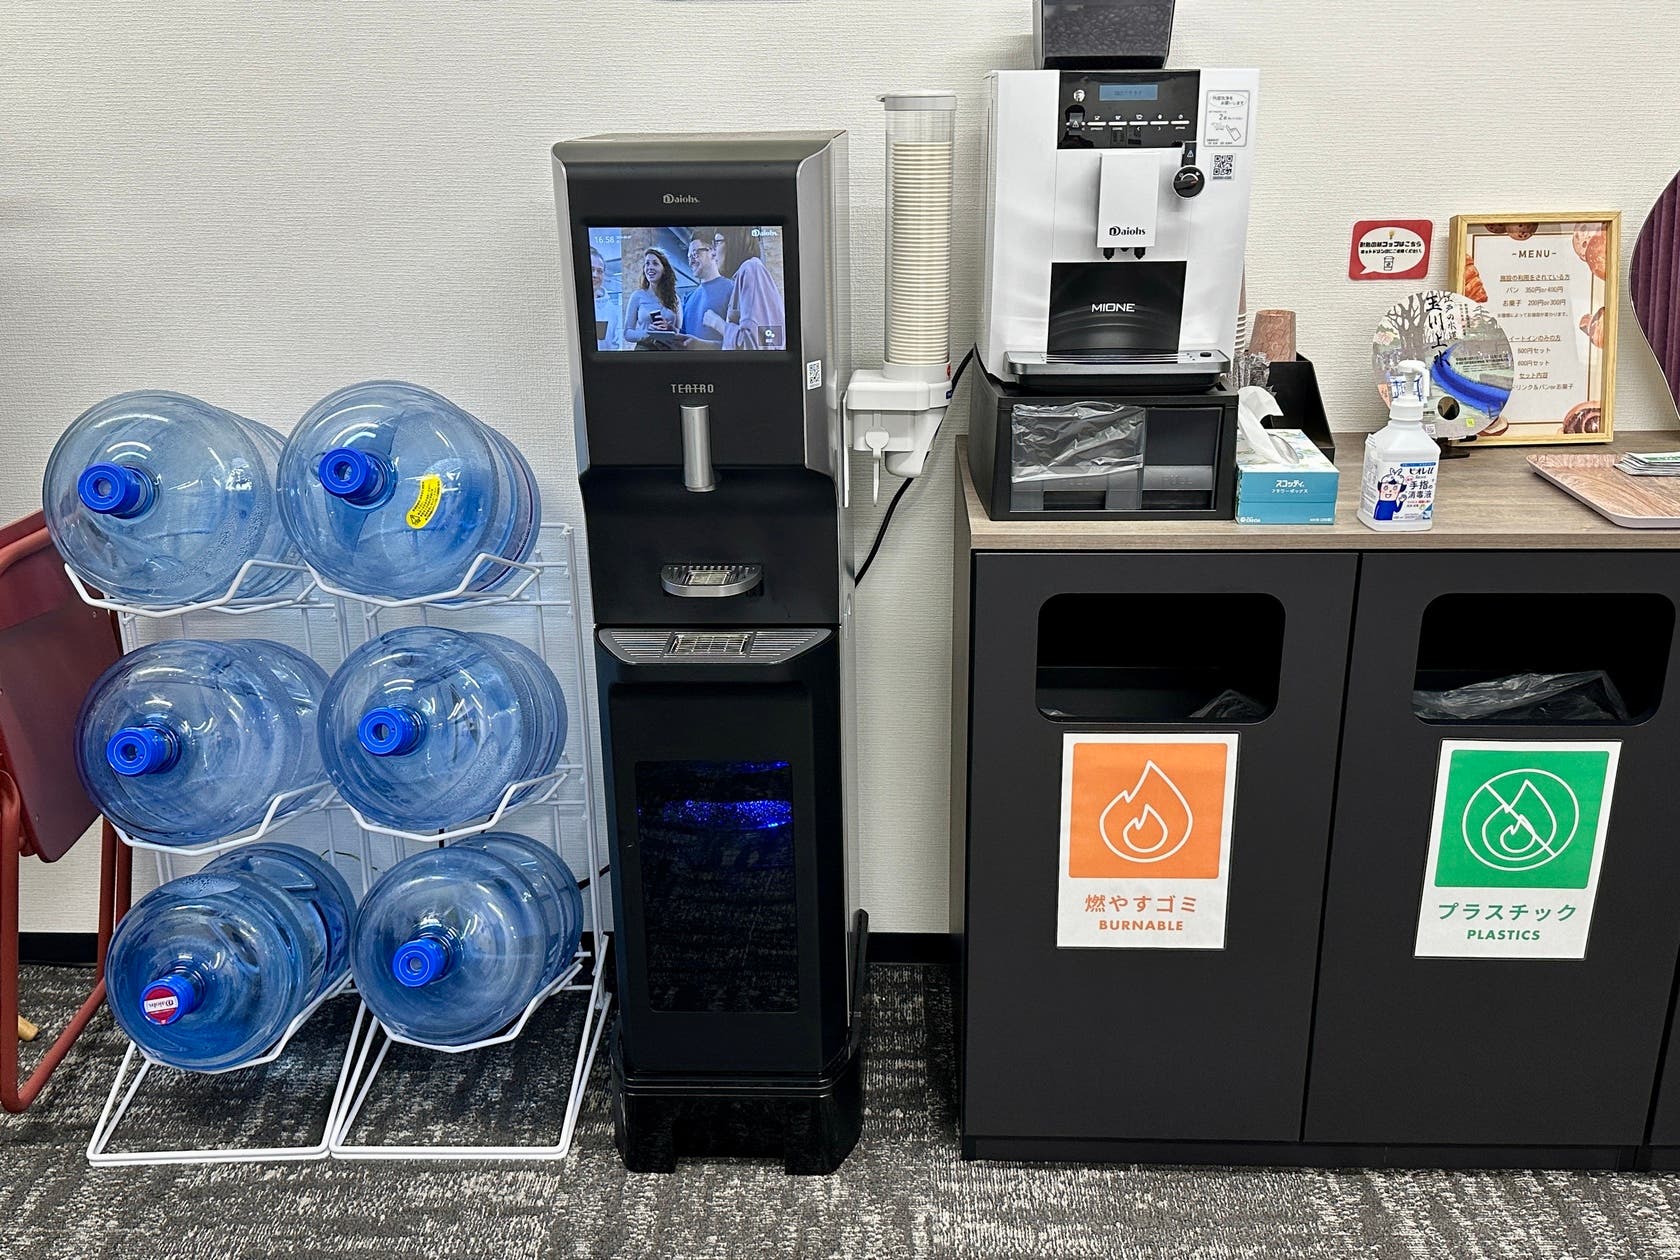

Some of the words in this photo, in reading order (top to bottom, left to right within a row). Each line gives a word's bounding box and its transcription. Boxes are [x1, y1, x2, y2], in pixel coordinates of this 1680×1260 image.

[662, 194, 699, 204] Daiohs
[1109, 226, 1146, 236] Daiohs
[1091, 303, 1135, 312] MIONE
[671, 384, 714, 393] TEATRO
[1408, 491, 1432, 499] 消毒液
[1085, 895, 1197, 913] 燃やすゴミ
[1438, 902, 1576, 921] プラスチック
[1099, 920, 1183, 931] BURNABLE
[1467, 929, 1541, 940] PLASTICS
